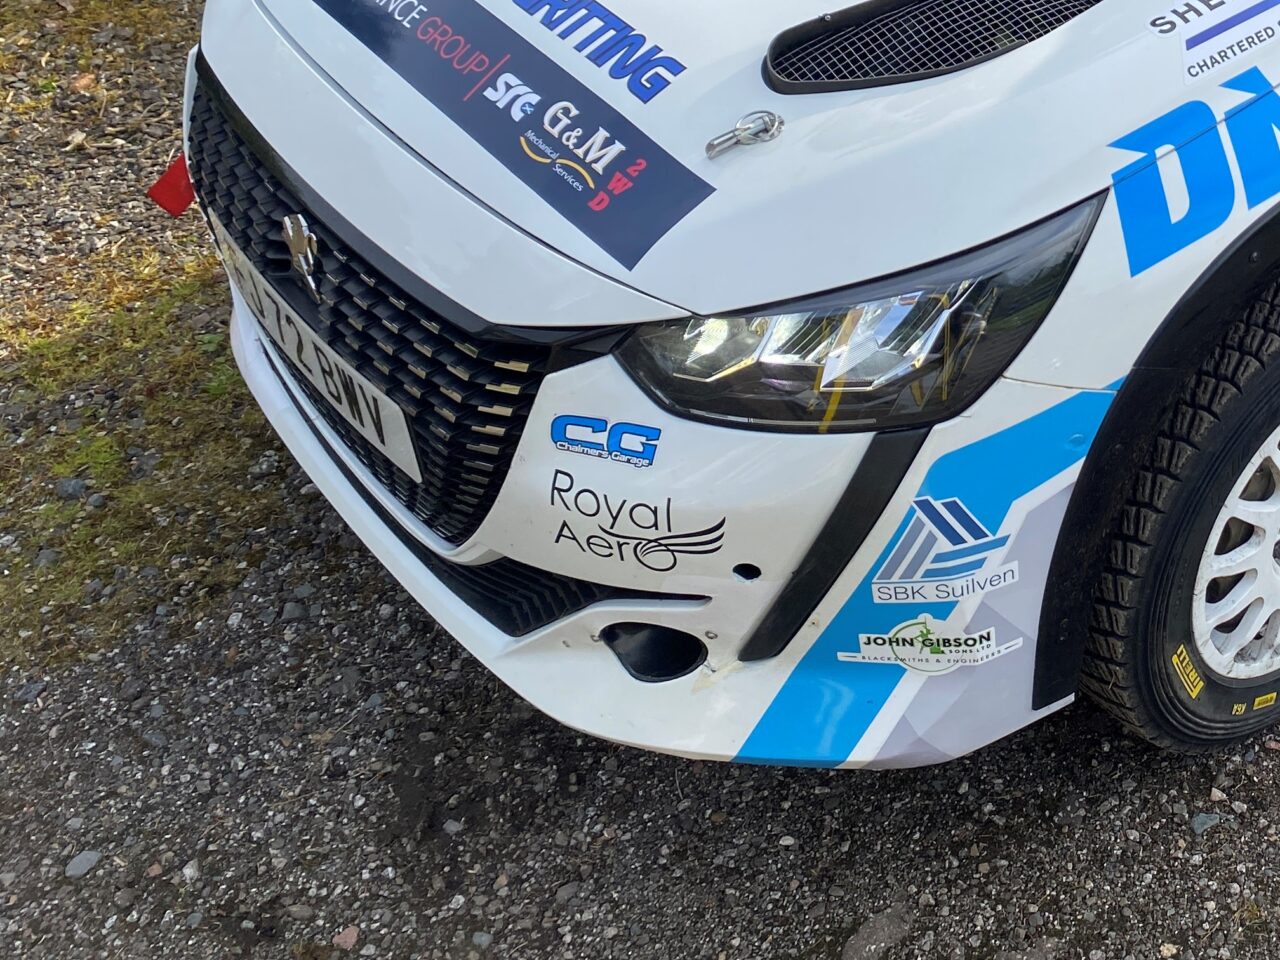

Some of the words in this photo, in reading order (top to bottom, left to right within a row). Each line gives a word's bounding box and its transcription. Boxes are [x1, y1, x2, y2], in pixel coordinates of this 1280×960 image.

[416, 16, 490, 75] GROUP
[1187, 25, 1276, 78] CHARTERED
[524, 129, 561, 160] Mechanical
[552, 163, 584, 192] Services
[311, 340, 386, 448] BWV
[551, 415, 662, 466] CG
[556, 441, 609, 459] Chalmers
[611, 451, 650, 467] Garage
[551, 469, 672, 533] Royal
[554, 520, 678, 572] Aero
[877, 584, 928, 601] SBK
[935, 568, 1016, 600] Suilven
[861, 655, 930, 663] BLACKSMITHS
[947, 650, 1001, 664] ENGINEERS
[863, 636, 915, 647] JOHN
[922, 631, 991, 647] GIBSON
[976, 643, 992, 653] LTD
[1172, 643, 1205, 700] PIRELLI
